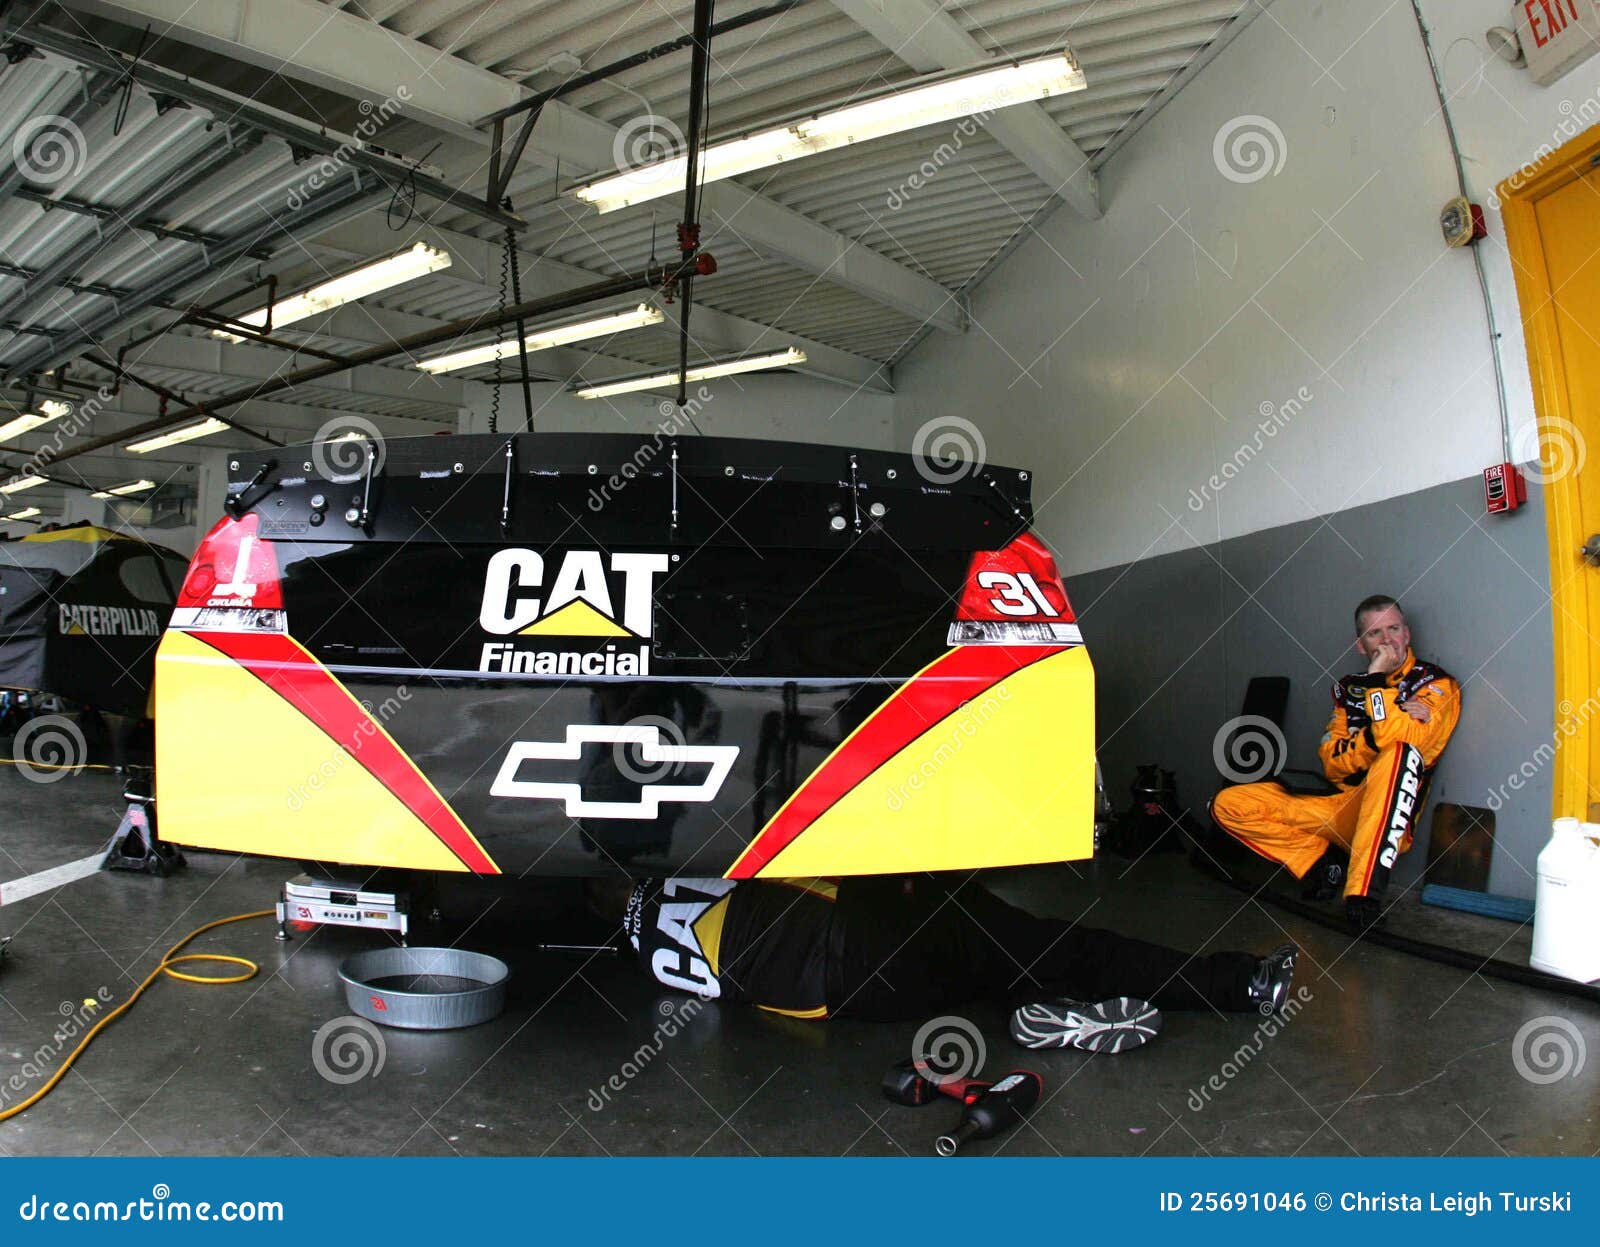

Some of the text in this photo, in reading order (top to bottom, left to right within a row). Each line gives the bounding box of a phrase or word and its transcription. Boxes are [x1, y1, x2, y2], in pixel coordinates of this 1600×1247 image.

[1485, 465, 1503, 479] FIRE
[479, 547, 669, 639] CAT
[977, 570, 1060, 617] 31
[59, 603, 161, 637] CATERPILLAR
[478, 642, 650, 677] Financial
[297, 906, 313, 920] 31
